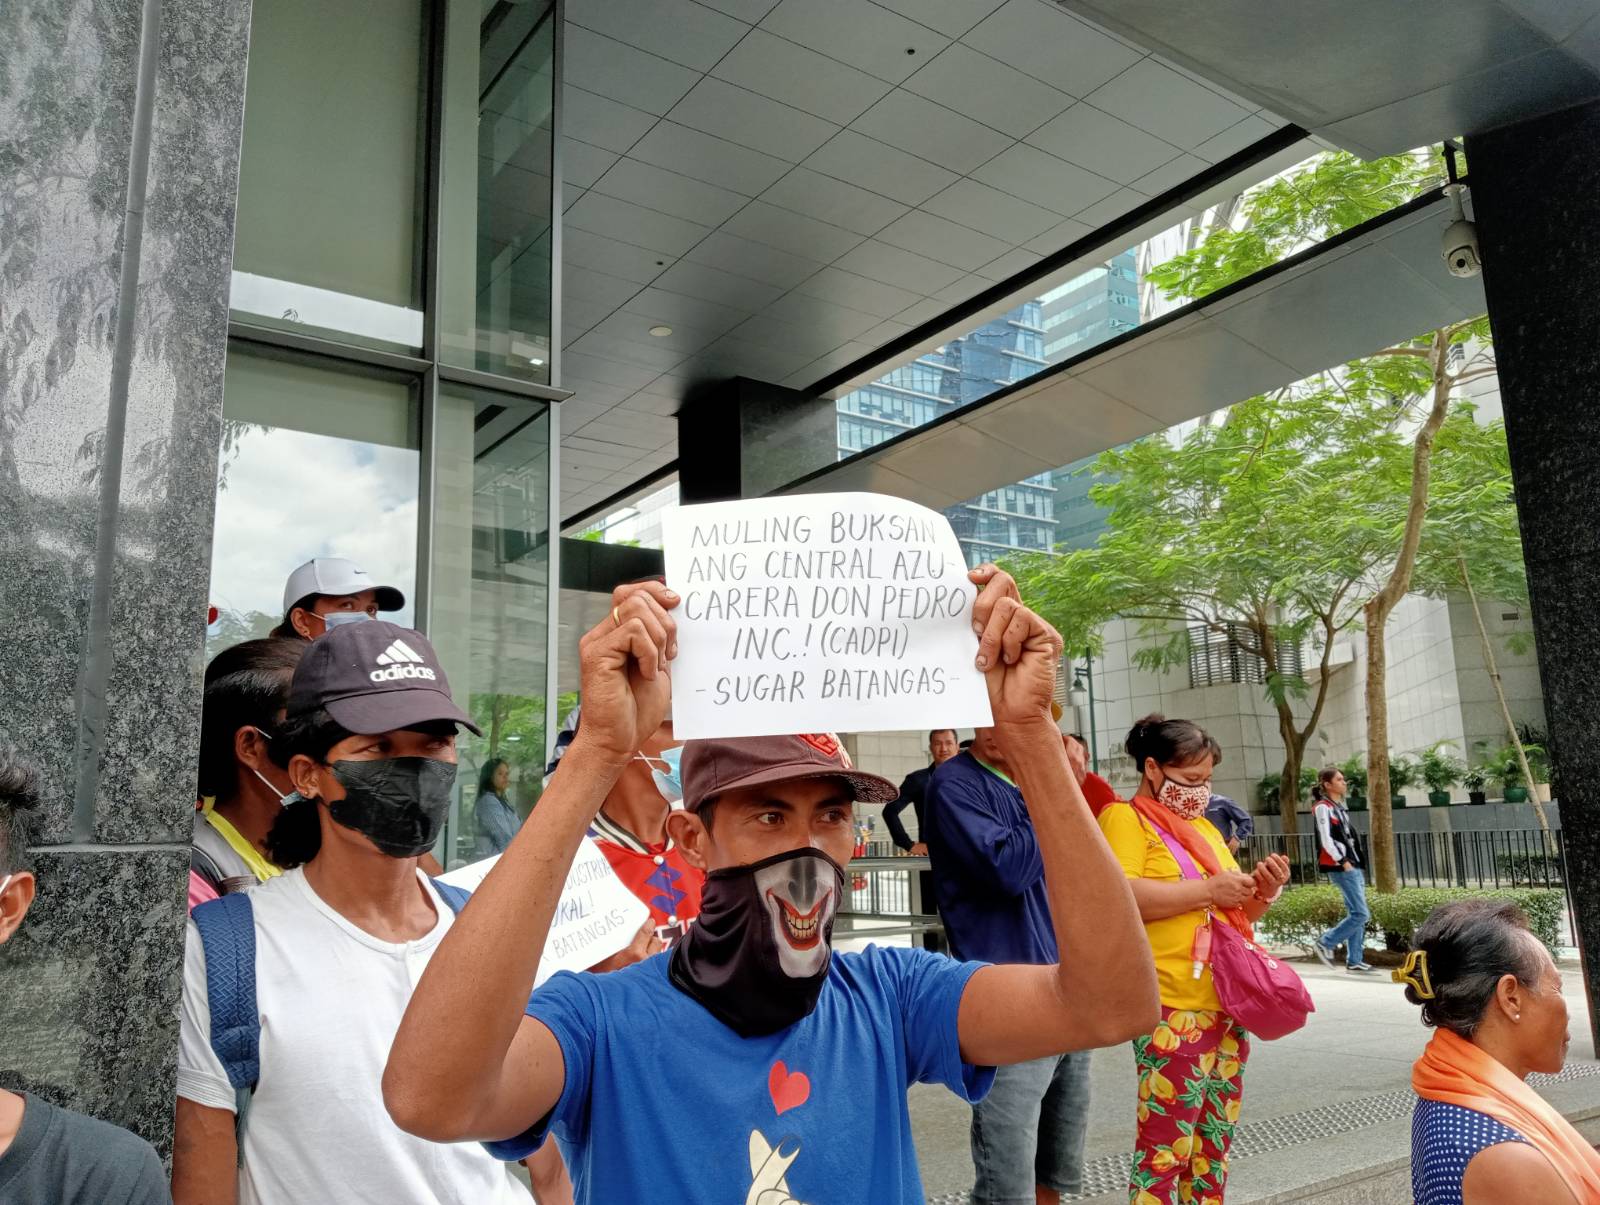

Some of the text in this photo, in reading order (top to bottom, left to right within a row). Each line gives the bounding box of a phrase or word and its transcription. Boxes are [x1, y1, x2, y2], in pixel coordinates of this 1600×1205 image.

[690, 511, 936, 549] MULING BUKSAN
[687, 552, 748, 584] ANG
[764, 547, 883, 580] CENTRAL
[685, 583, 967, 622] CARERA DON PEDRO
[820, 620, 909, 660] (CADPI)
[369, 663, 436, 682] adidas
